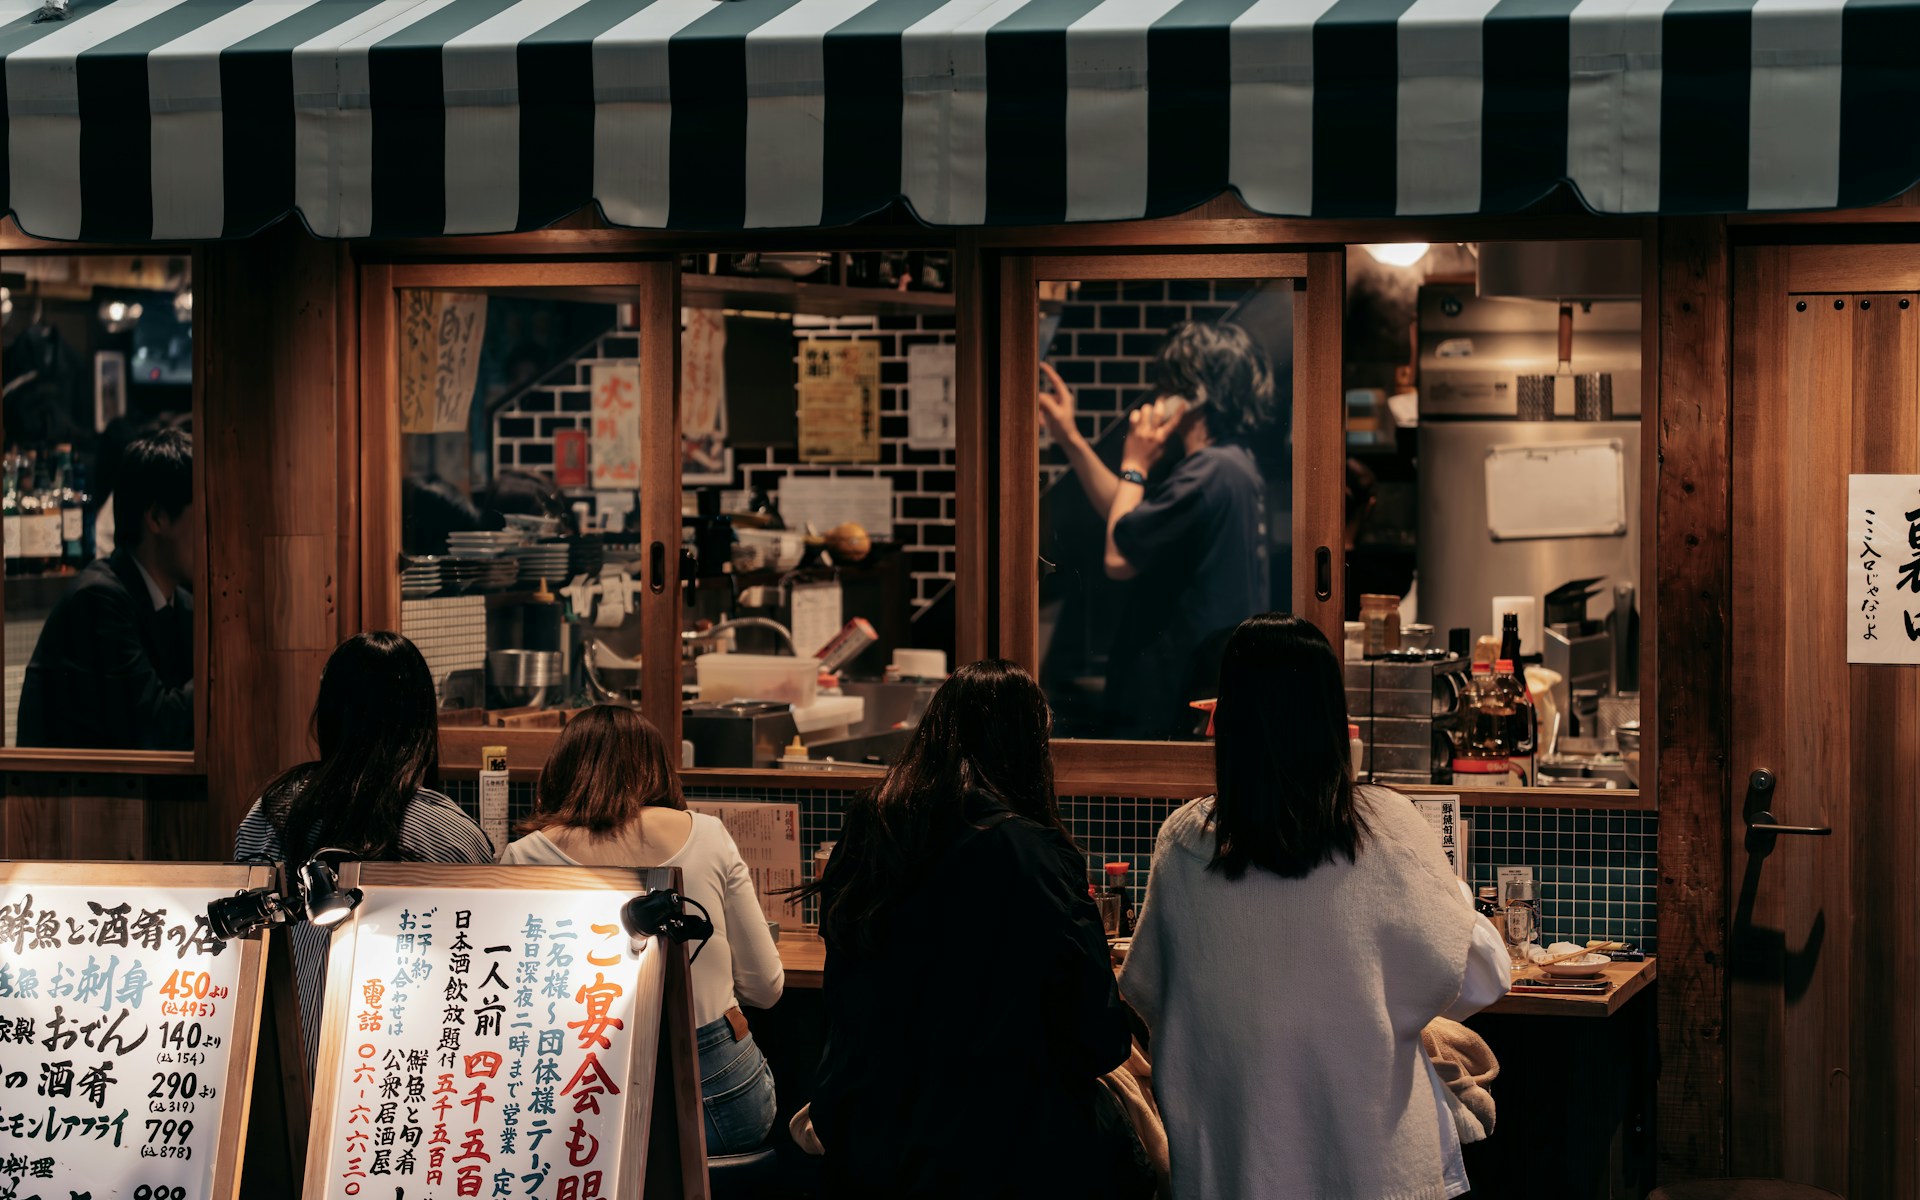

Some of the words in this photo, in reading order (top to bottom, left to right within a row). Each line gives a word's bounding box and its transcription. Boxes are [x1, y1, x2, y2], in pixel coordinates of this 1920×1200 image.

[47, 954, 153, 1012] お刺身
[388, 909, 417, 1036] お問い合わせは
[41, 1004, 148, 1056] おでん
[520, 919, 578, 1200] 二名様〜団体様テーブ
[0, 1106, 129, 1148] ーモンレアフライ
[144, 1118, 194, 1146] 799
[370, 1049, 405, 1175] 公衆居酒屋
[0, 1152, 55, 1178] 料理
[492, 1167, 516, 1200] 定
